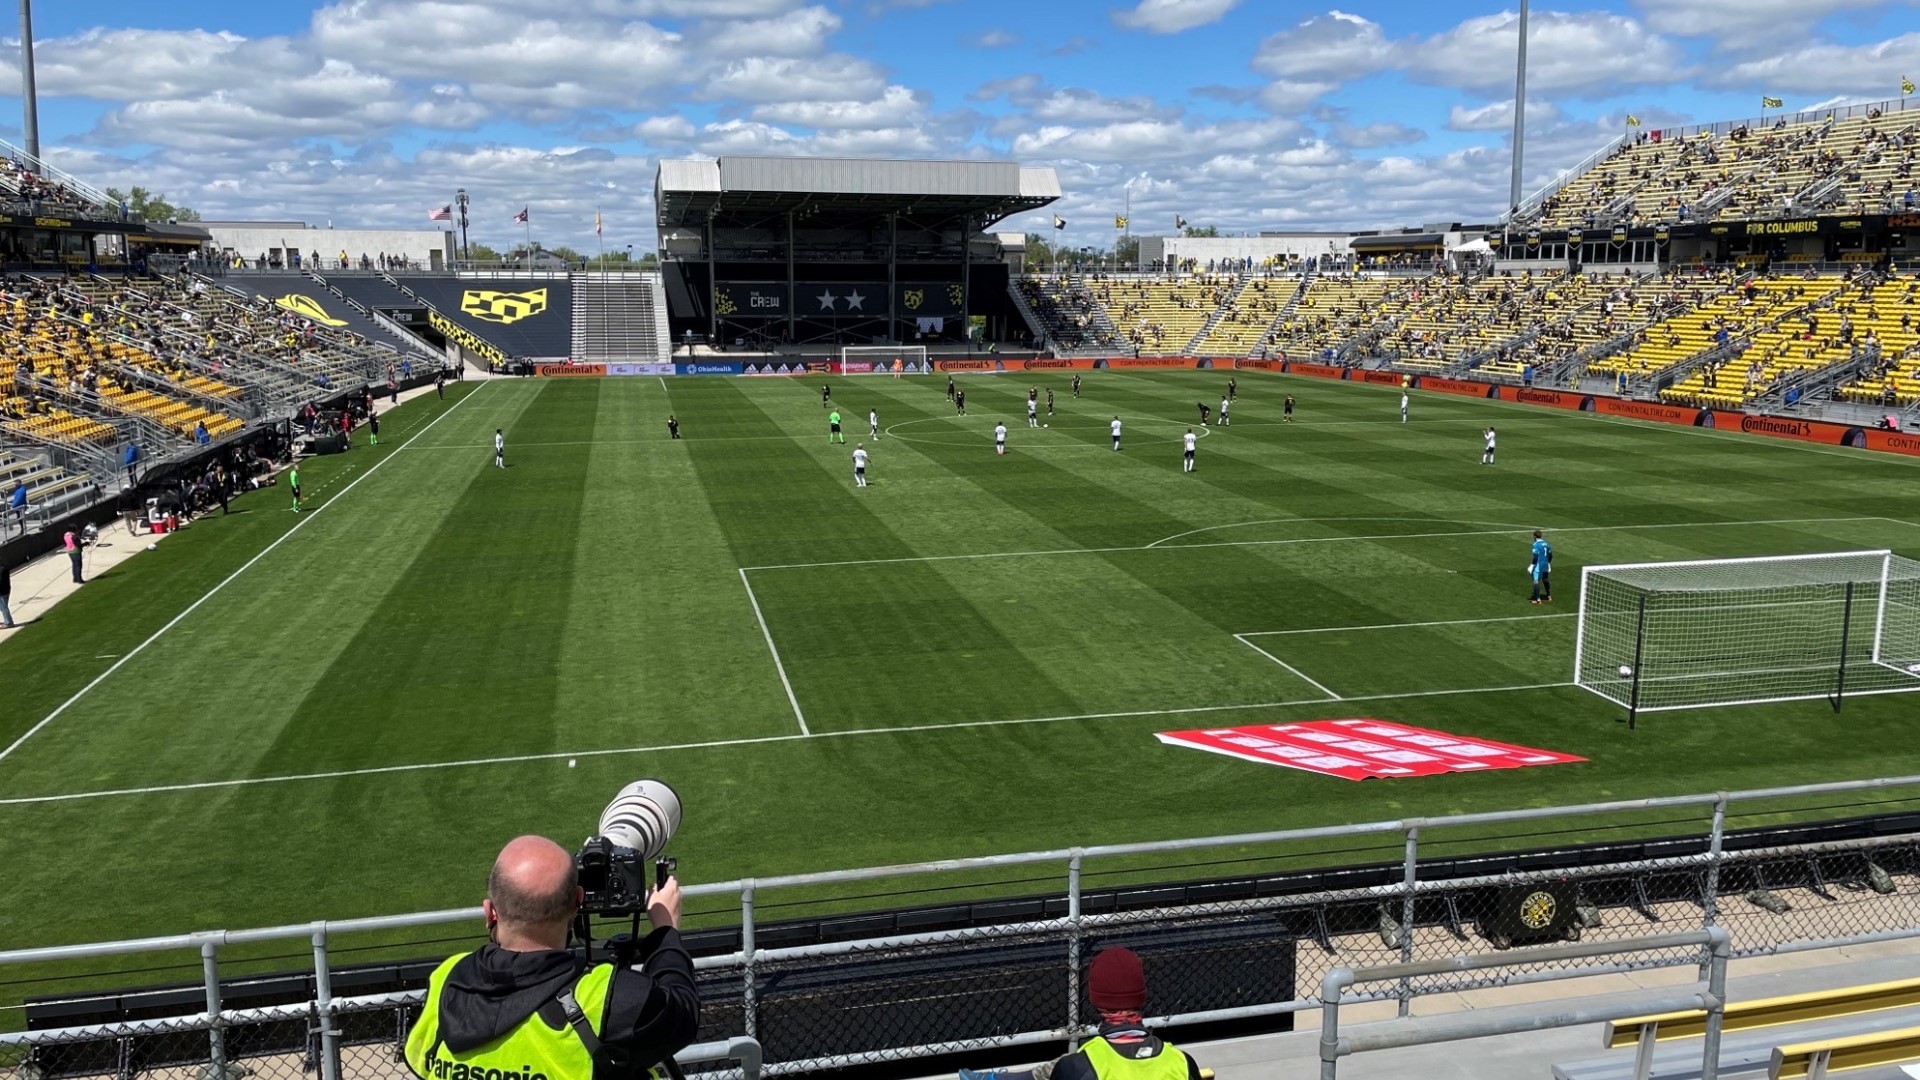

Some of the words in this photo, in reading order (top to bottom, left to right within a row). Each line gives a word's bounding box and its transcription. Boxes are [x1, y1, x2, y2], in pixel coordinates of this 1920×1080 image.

[1766, 221, 1818, 234] COLUMBUS
[750, 297, 779, 307] CREW
[542, 364, 593, 376] Continental
[940, 360, 983, 371] Continental
[1024, 360, 1067, 370] Continental
[1517, 389, 1556, 404] Continental
[1608, 402, 1681, 420] CONTINENTALTIRE.COM
[1741, 416, 1801, 436] Continental
